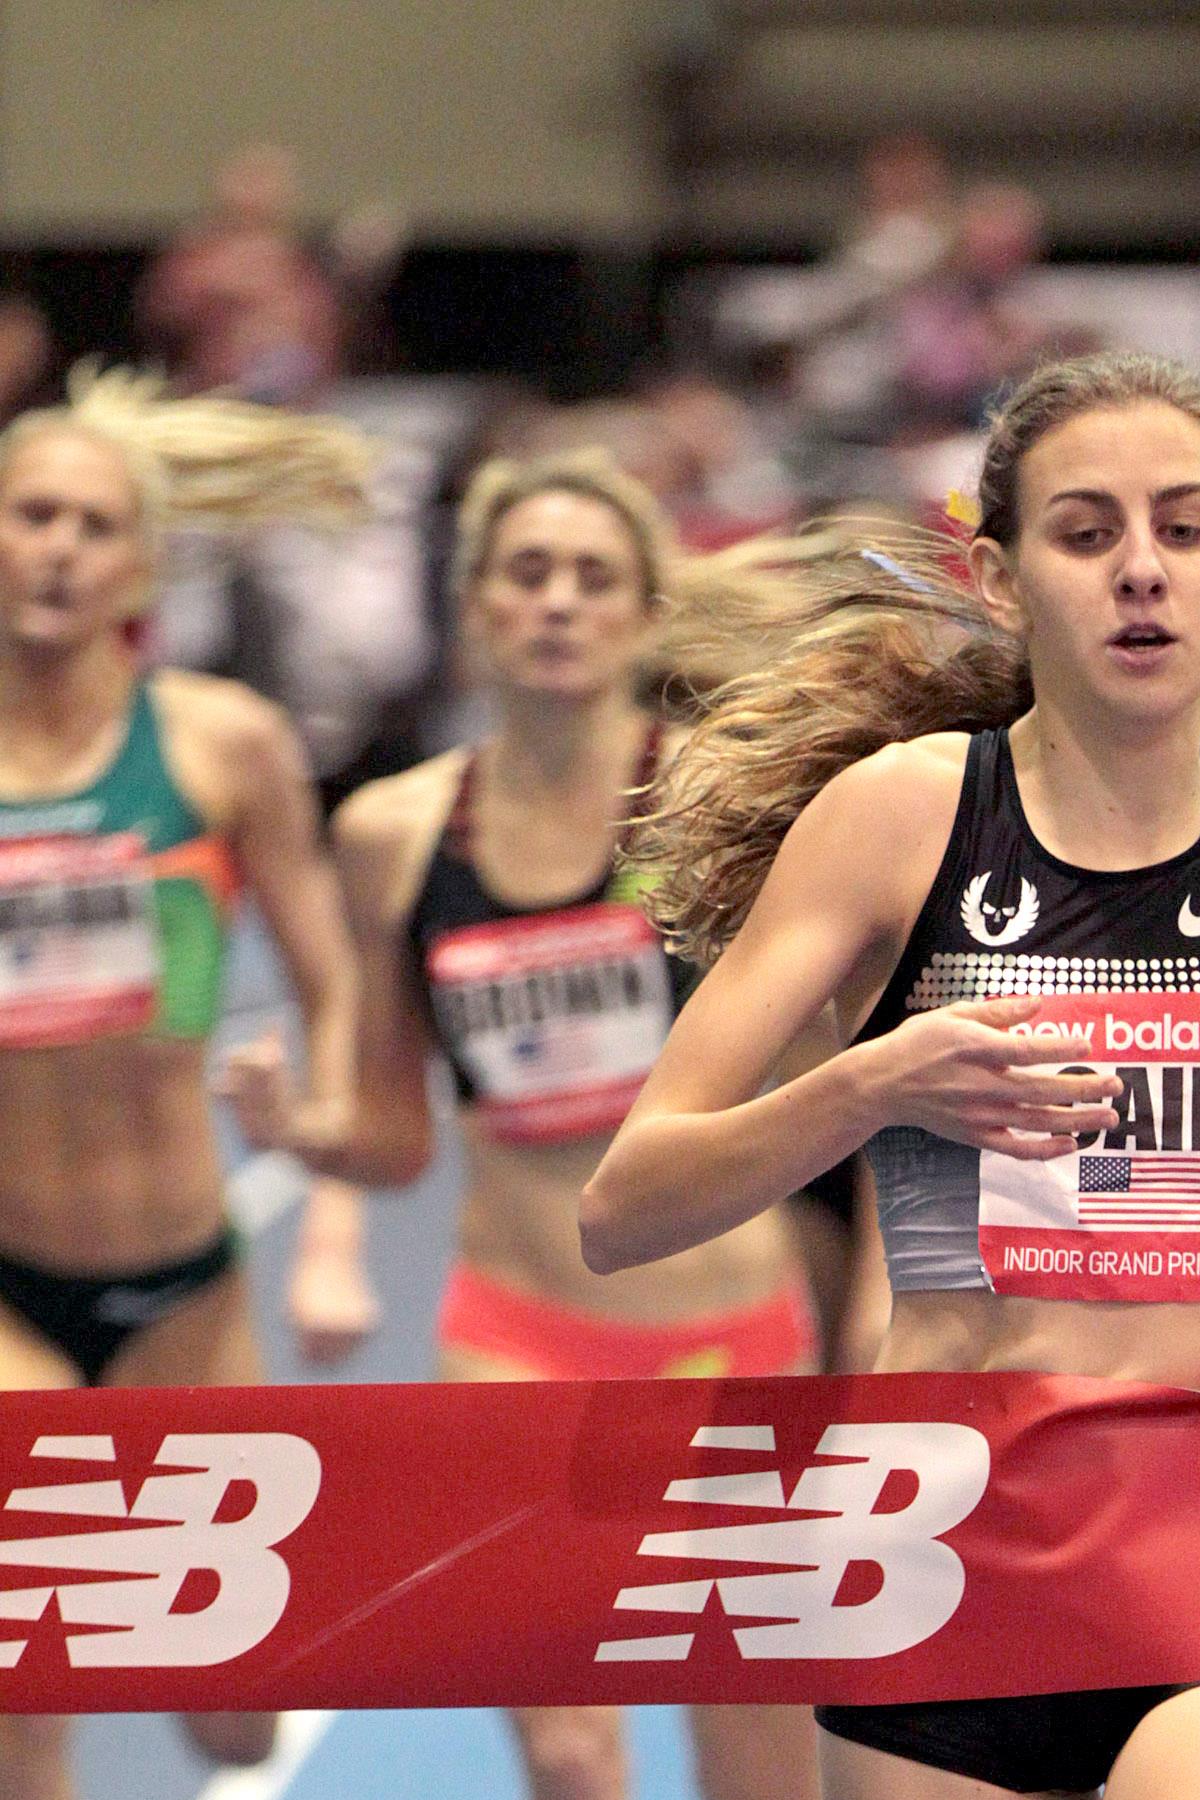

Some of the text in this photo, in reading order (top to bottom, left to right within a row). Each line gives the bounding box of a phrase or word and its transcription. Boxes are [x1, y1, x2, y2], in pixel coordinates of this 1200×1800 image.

[1003, 1246, 1084, 1274] INDOOR
[1088, 1250, 1163, 1276] GRAND
[594, 1421, 991, 1662] NB
